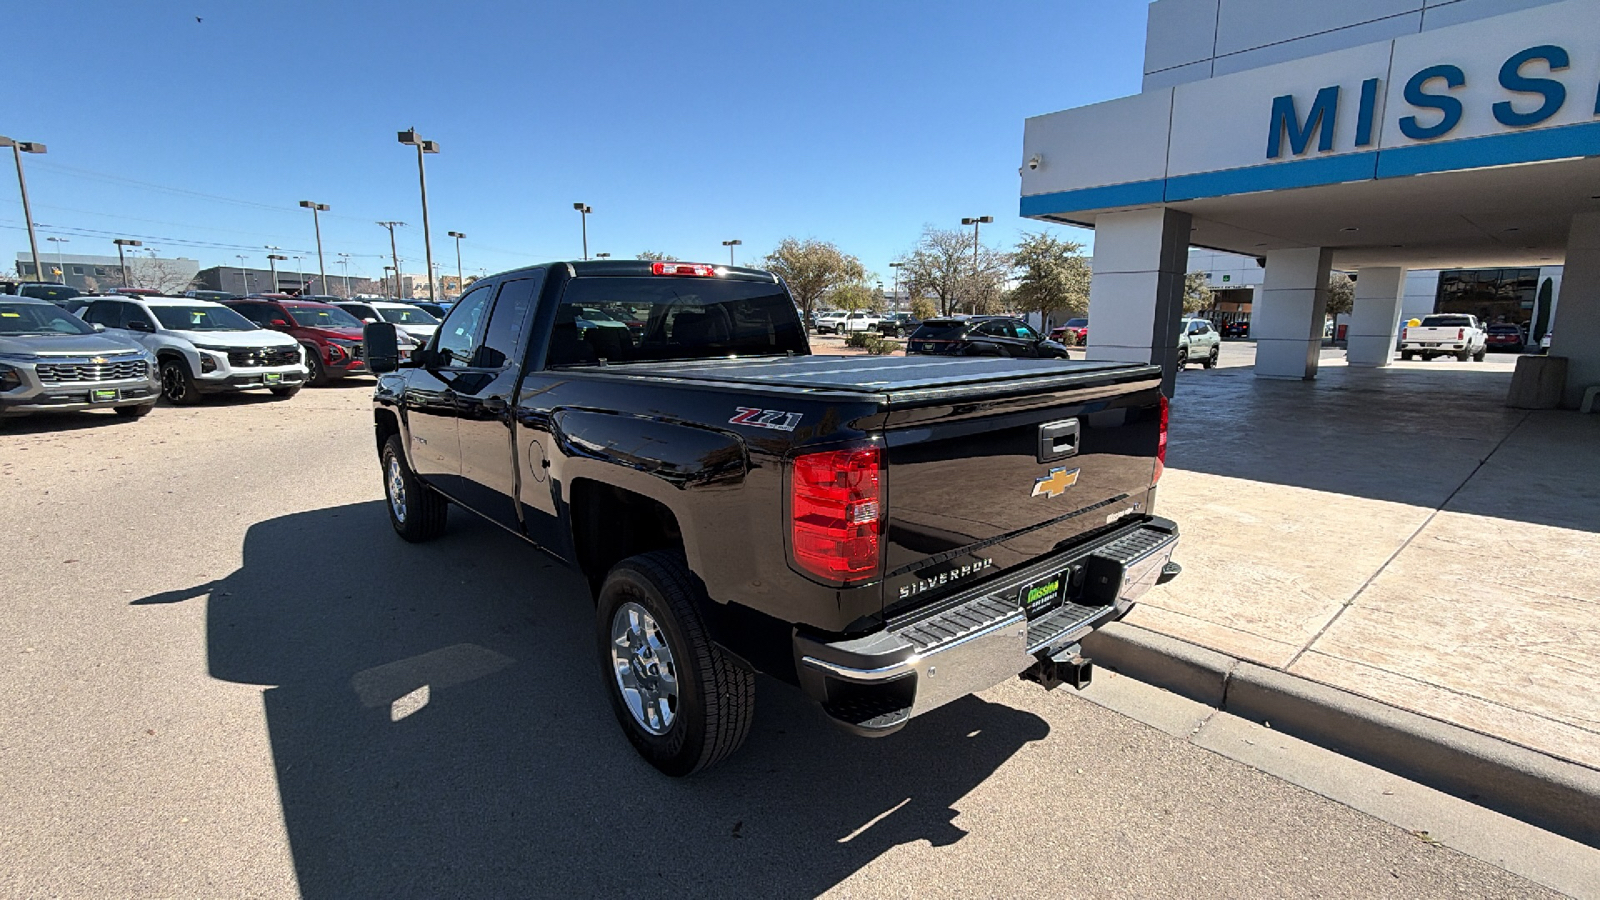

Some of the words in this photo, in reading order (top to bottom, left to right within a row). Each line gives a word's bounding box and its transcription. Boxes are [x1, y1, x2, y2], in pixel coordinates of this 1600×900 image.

[1266, 44, 1600, 159] MISS
[728, 406, 804, 432] Z71
[899, 558, 993, 599] SILVERADO
